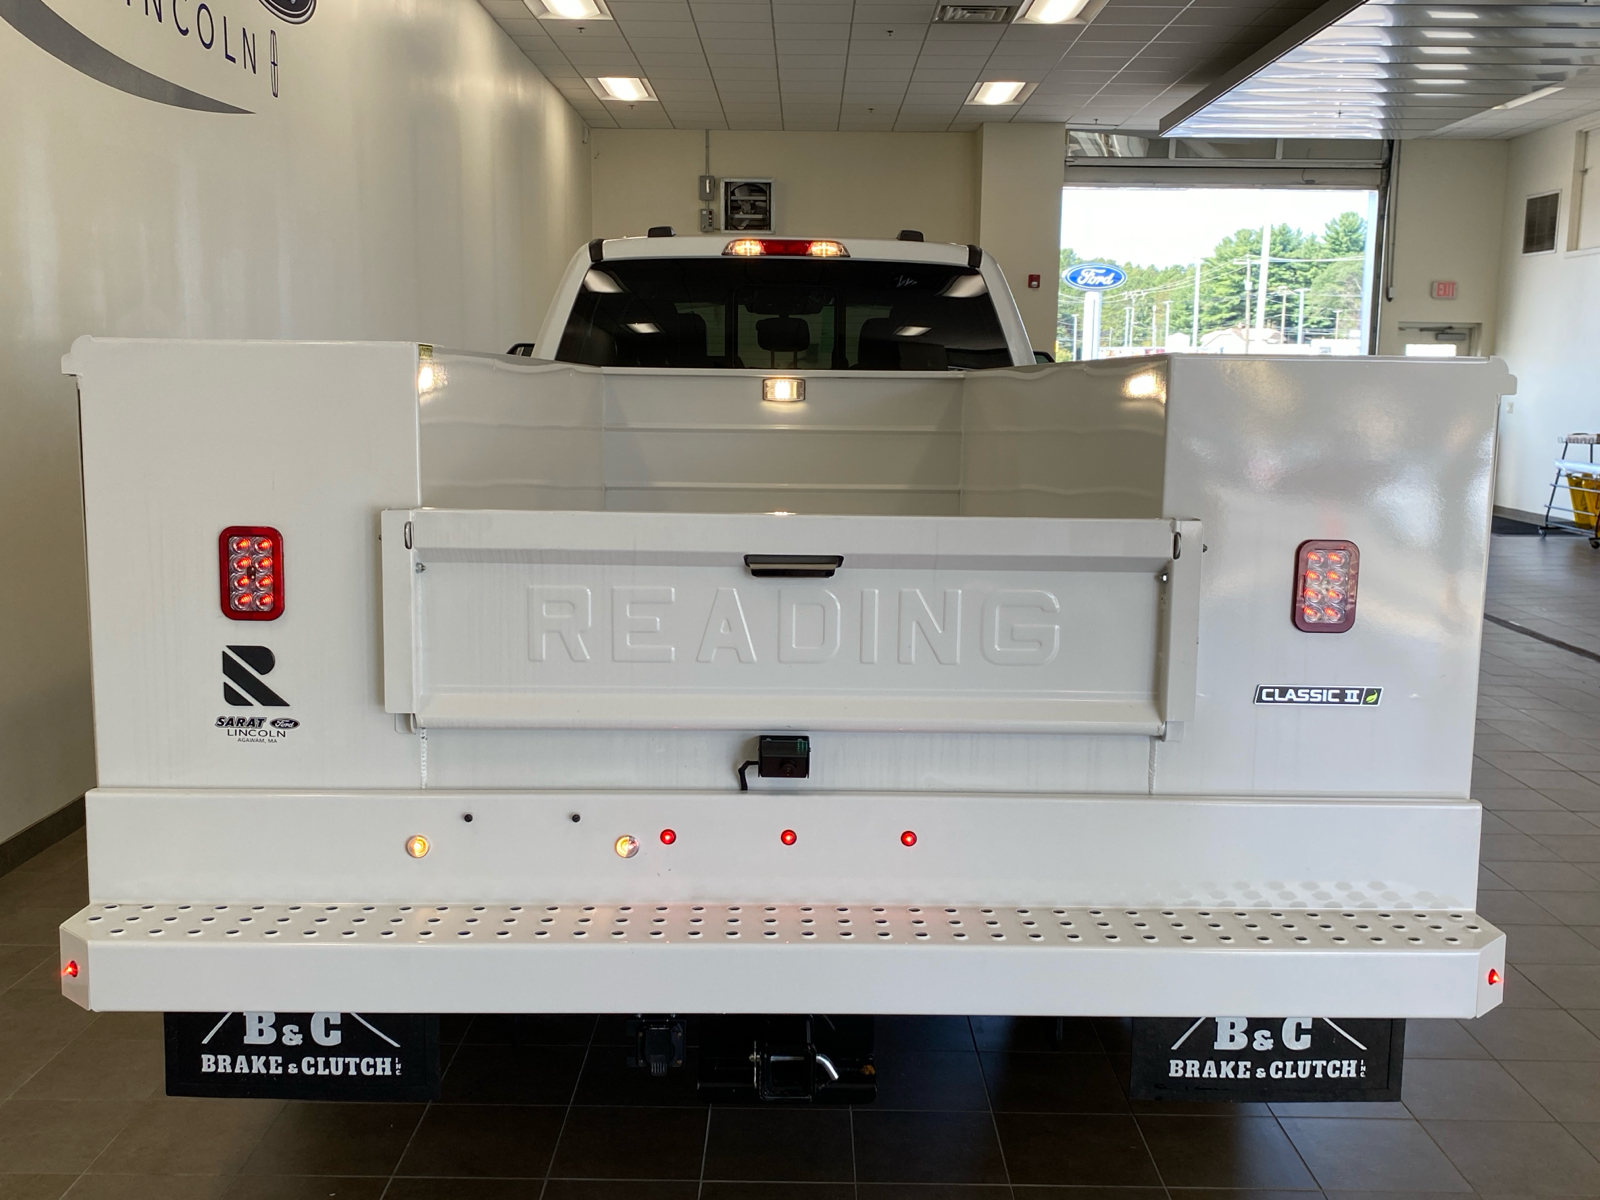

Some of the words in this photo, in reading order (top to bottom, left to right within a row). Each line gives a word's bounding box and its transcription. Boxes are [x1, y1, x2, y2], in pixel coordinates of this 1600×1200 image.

[1077, 268, 1115, 285] Ford
[1436, 281, 1456, 297] EXIT
[526, 584, 1061, 666] READING
[1261, 688, 1341, 702] CLASSIC
[1344, 689, 1360, 702] II
[215, 716, 267, 729] SARAT
[227, 729, 286, 738] LINCOLN
[201, 1054, 283, 1075] BRAKE
[287, 1063, 299, 1074] &
[301, 1056, 392, 1076] CLUTCH
[1168, 1059, 1252, 1079] BRAKE
[1255, 1067, 1267, 1079] &
[1269, 1059, 1358, 1079] CLUTCH
